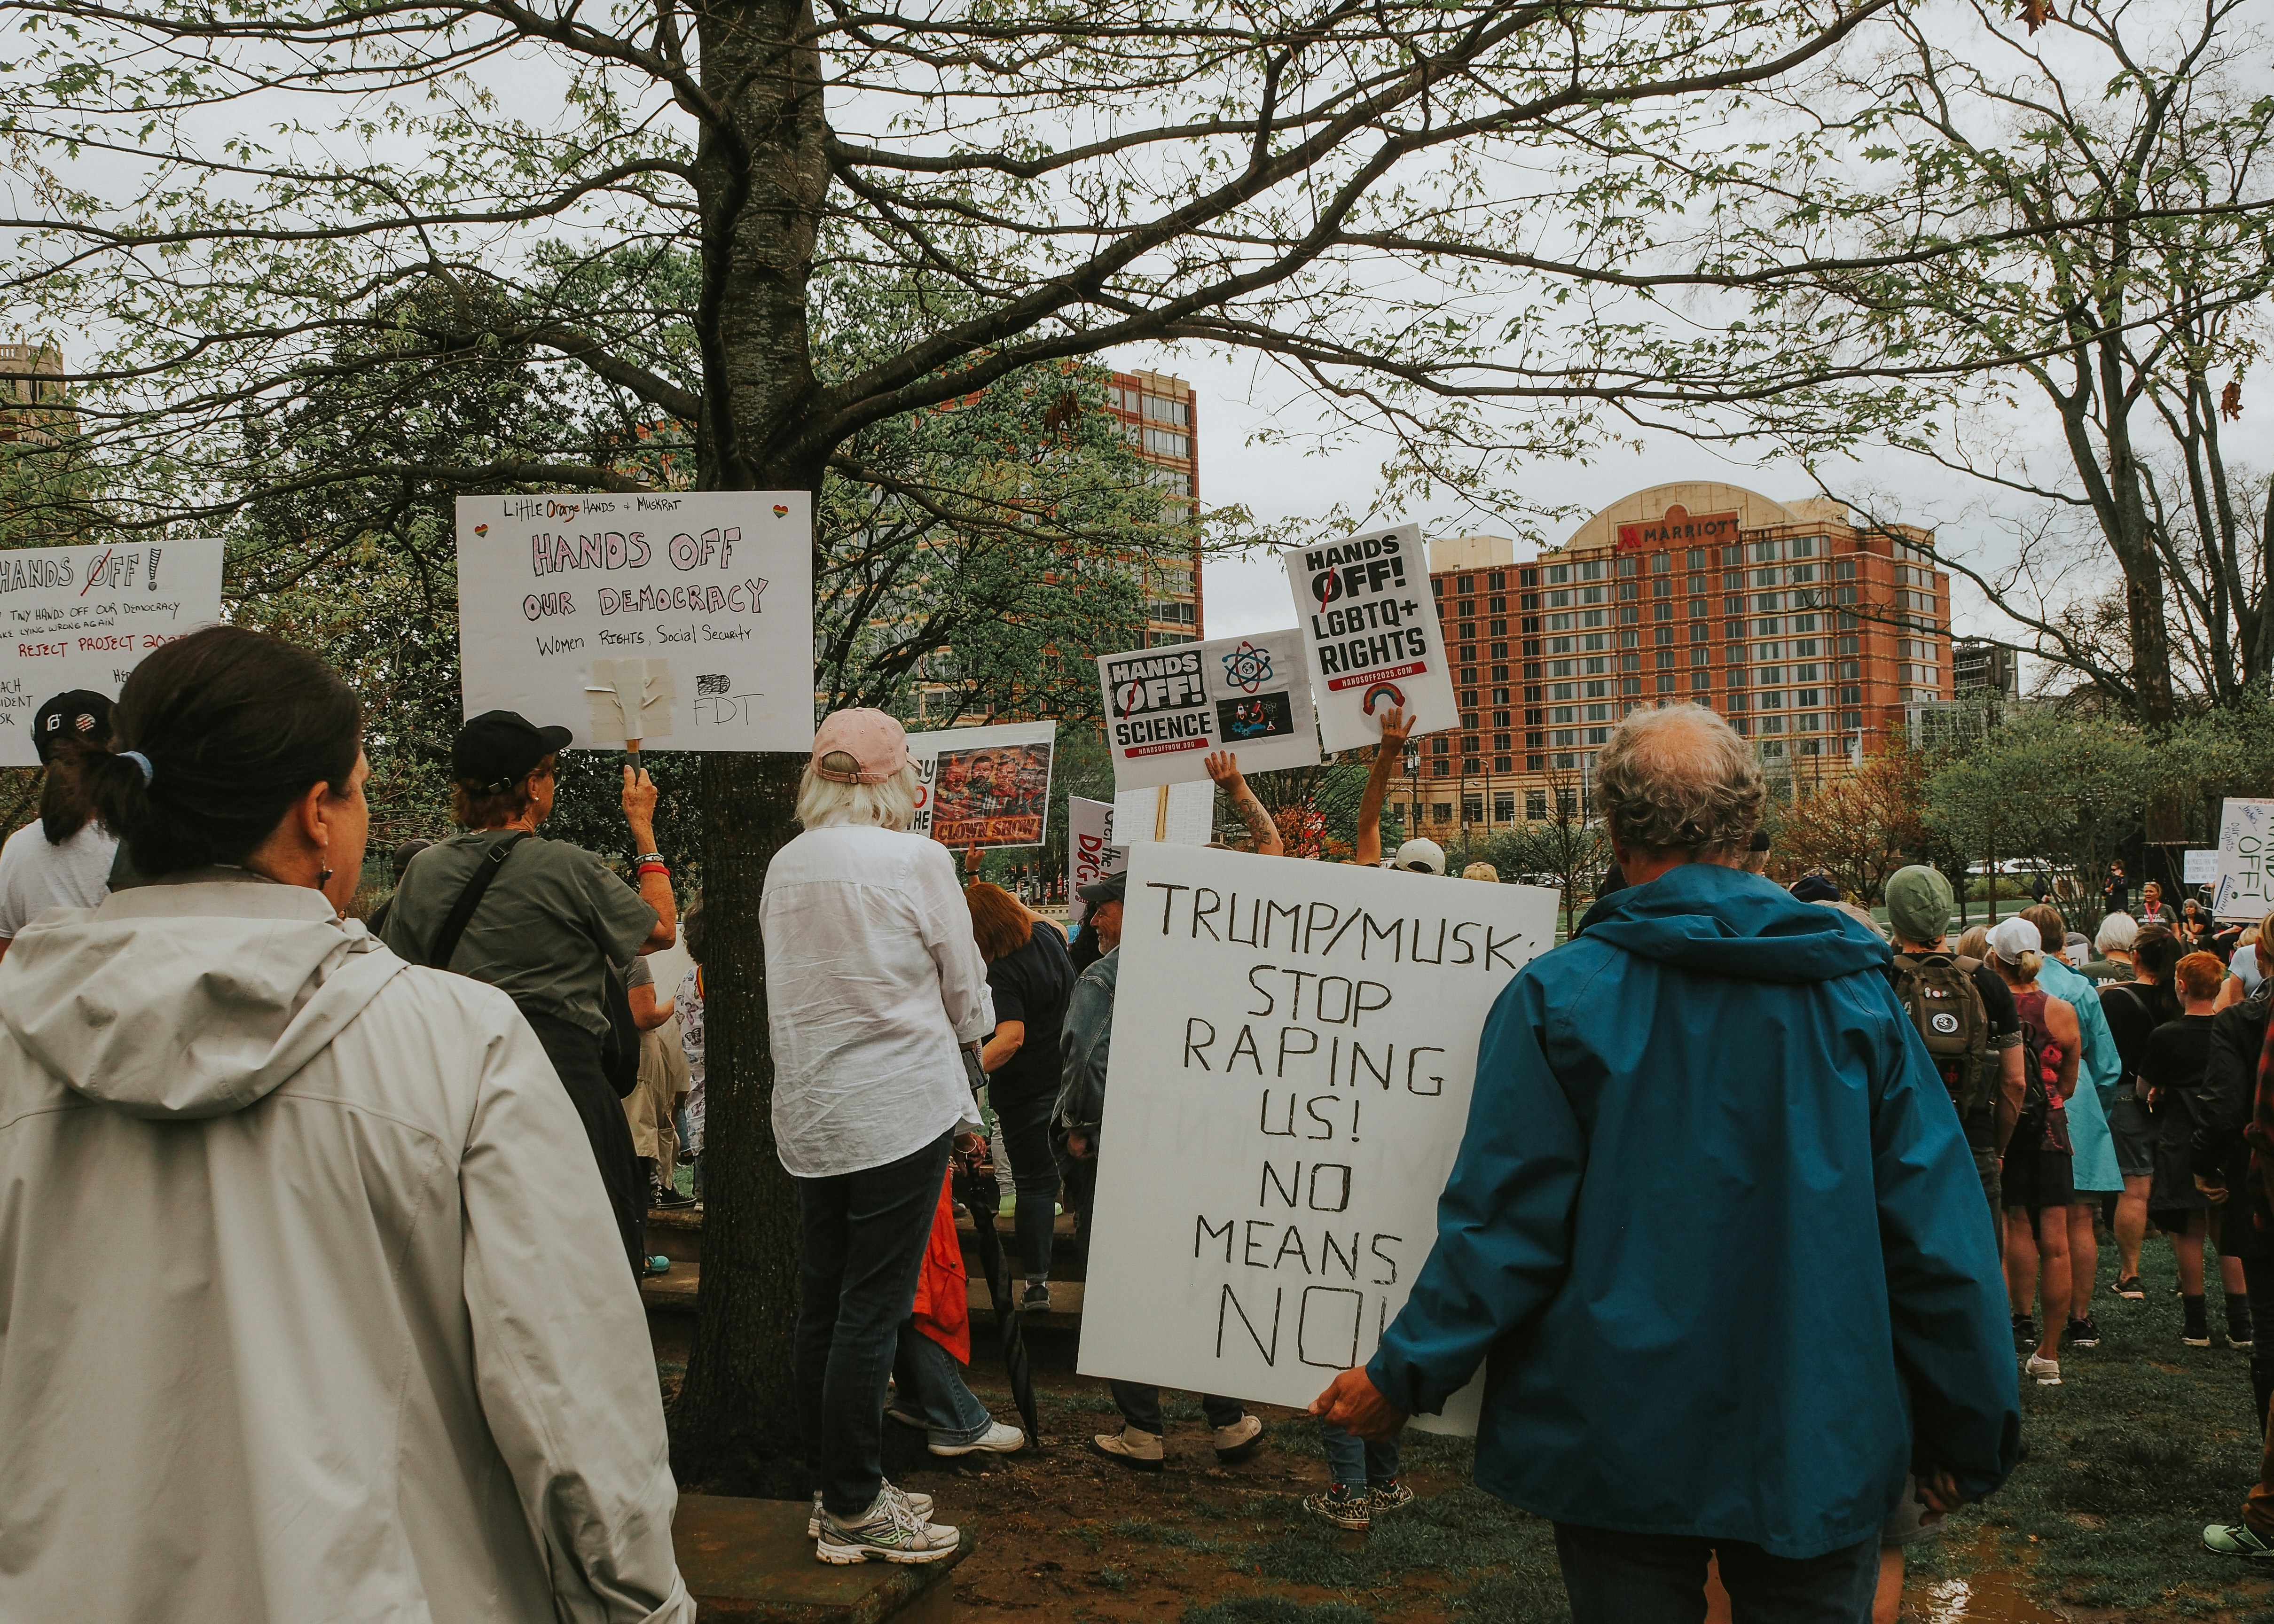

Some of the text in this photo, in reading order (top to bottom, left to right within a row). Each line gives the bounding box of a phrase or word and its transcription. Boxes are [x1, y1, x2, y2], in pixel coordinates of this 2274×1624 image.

[583, 498, 615, 515] HANDS
[1644, 519, 1740, 542] MARRIOTT
[532, 527, 741, 577] HANDS OFF
[1305, 534, 1400, 572] HANDS
[0, 556, 74, 594] HANDS
[1311, 555, 1406, 603] OFF!
[36, 608, 64, 621] HANDS
[71, 607, 89, 617] OFF
[96, 602, 118, 617] OUR
[123, 602, 180, 620] DEMOCRACY
[523, 578, 768, 621] OUR DEMOCRACY
[1310, 598, 1419, 640] LGBTQ+
[18, 634, 188, 657] REJECT PROJECT 20
[1317, 627, 1427, 676] RIGHTS
[0, 678, 21, 694] ACH
[1111, 654, 1198, 683] HANDS
[1341, 666, 1413, 687] HANDSOFF2025.COM
[0, 695, 33, 708] IDENT
[693, 694, 765, 726] FDT
[1116, 673, 1203, 712] OFF!
[1115, 711, 1213, 746] SCIENCE
[1138, 741, 1195, 755] HANDSOFFNOW.ORG
[937, 818, 1037, 840] CLOWN SHOW
[1101, 847, 1121, 867] the
[1247, 964, 1393, 1028] STOP
[1184, 1017, 1446, 1096] RAPING
[1260, 1089, 1361, 1143] US!
[1260, 1161, 1352, 1213] NO
[1194, 1215, 1403, 1285] MEANS
